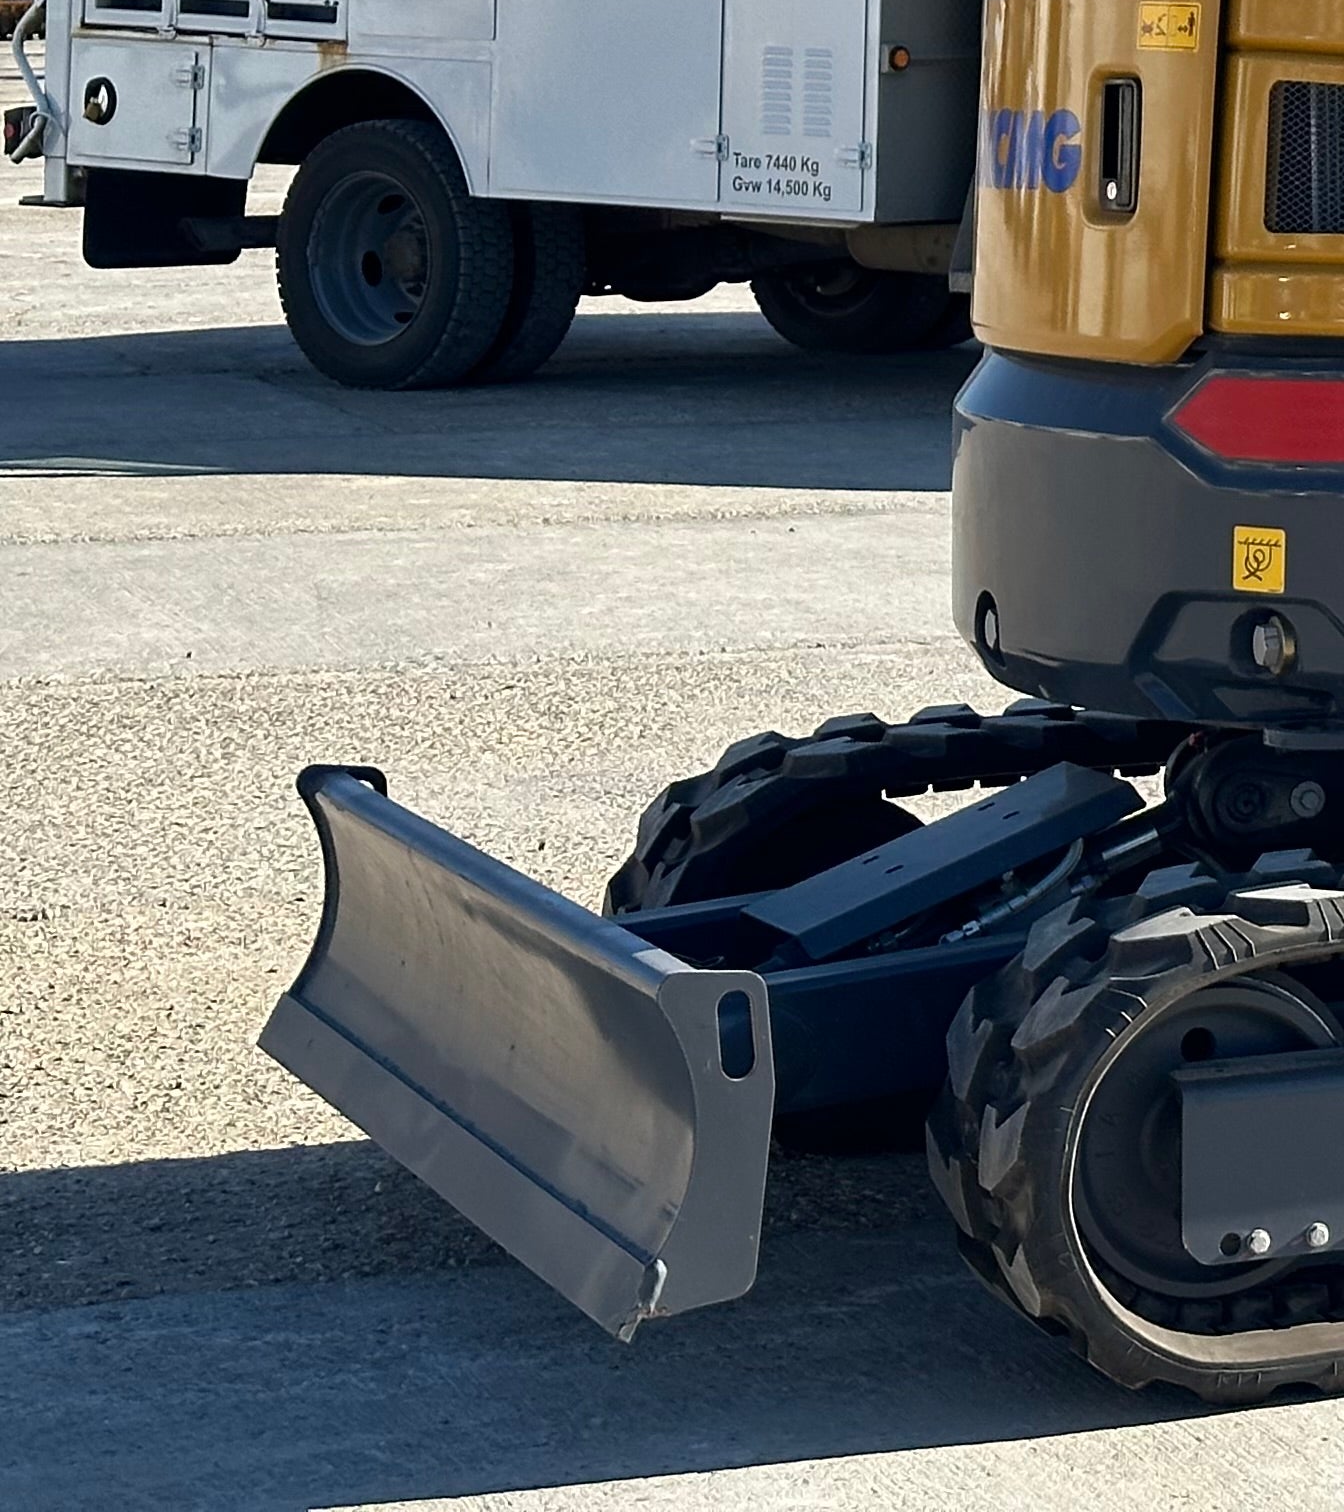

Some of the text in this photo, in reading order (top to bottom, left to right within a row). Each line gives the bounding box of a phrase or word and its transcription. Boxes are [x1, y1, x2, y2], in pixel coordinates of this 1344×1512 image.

[733, 152, 819, 177] Tare 7440 Kg
[766, 178, 809, 197] 14,500
[812, 181, 832, 202] Kg
